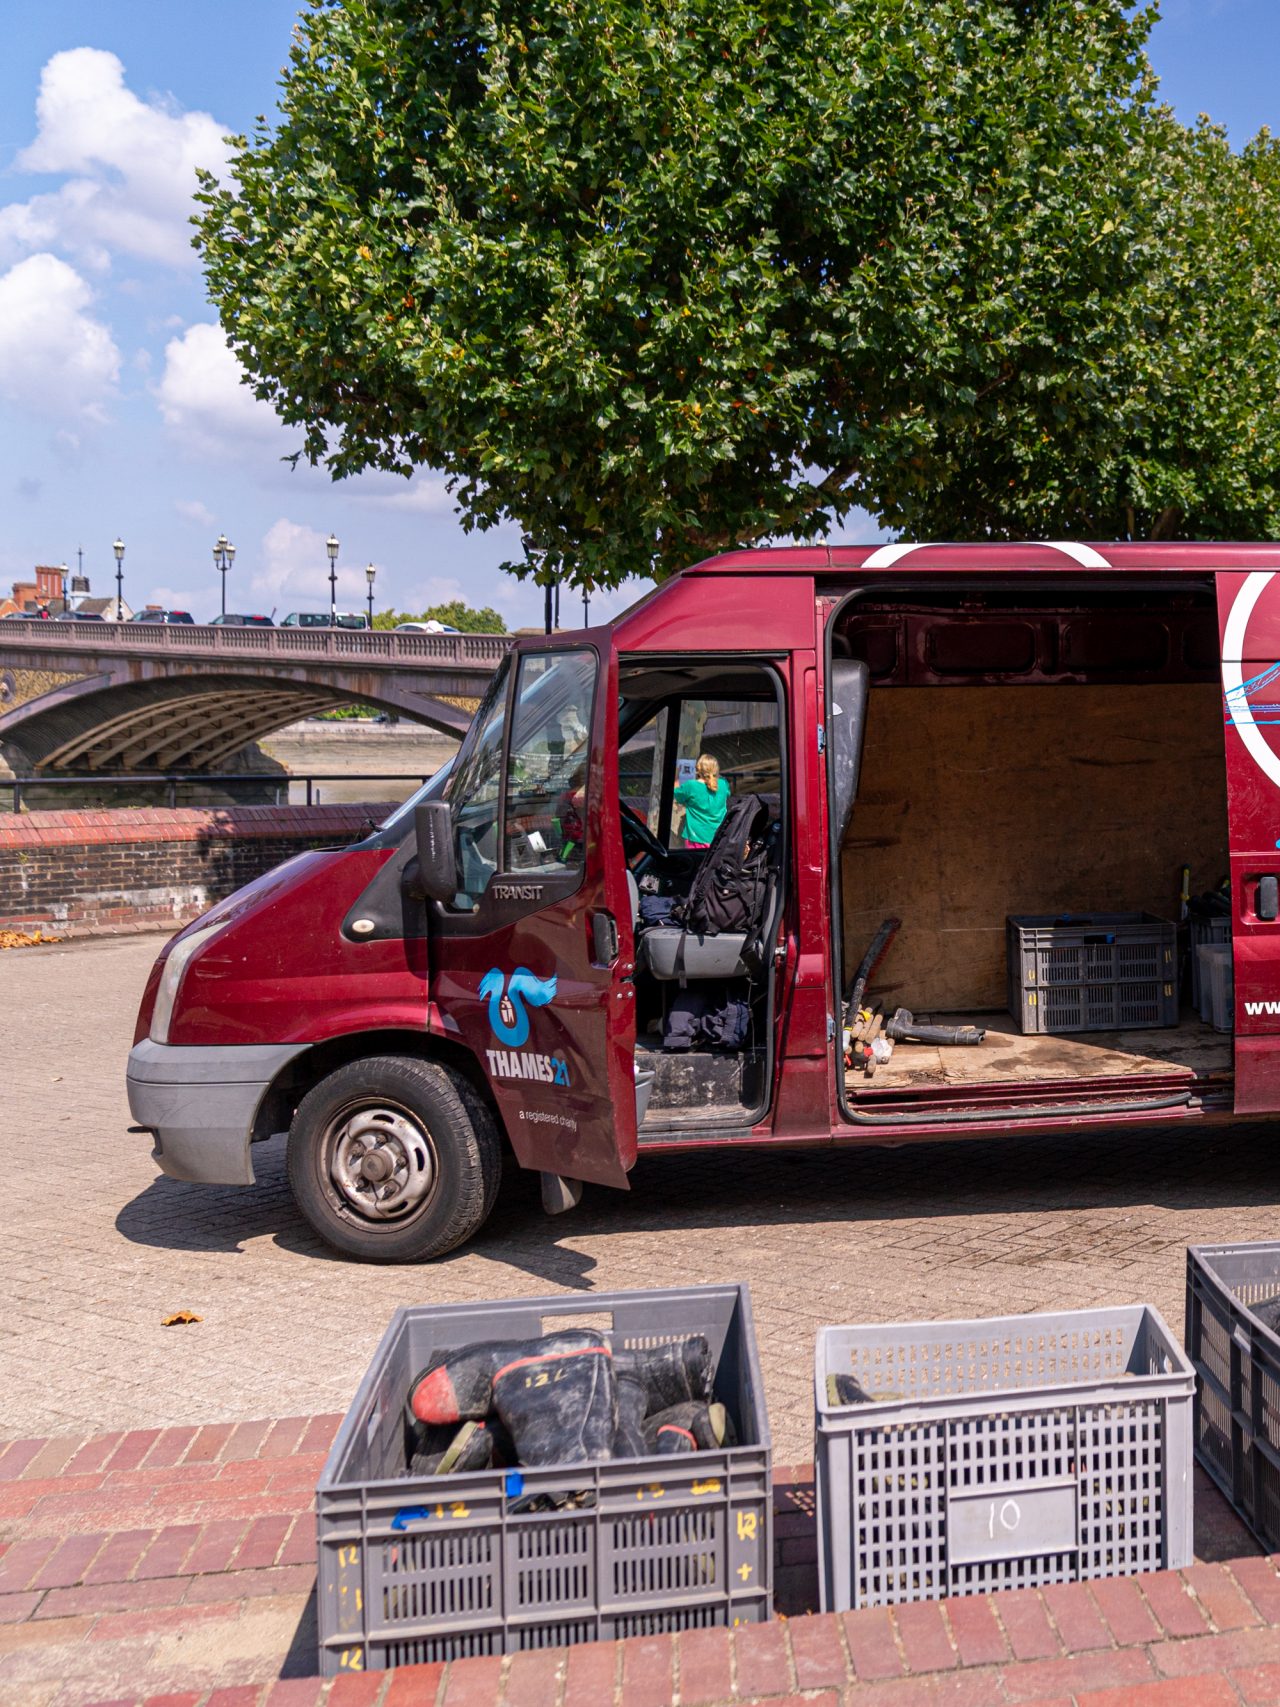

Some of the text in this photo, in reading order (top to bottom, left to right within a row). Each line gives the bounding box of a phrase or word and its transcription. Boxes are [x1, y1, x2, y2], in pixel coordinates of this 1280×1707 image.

[492, 885, 543, 900] TRANSIT
[525, 1111, 559, 1124] registered
[989, 1499, 1021, 1539] 10
